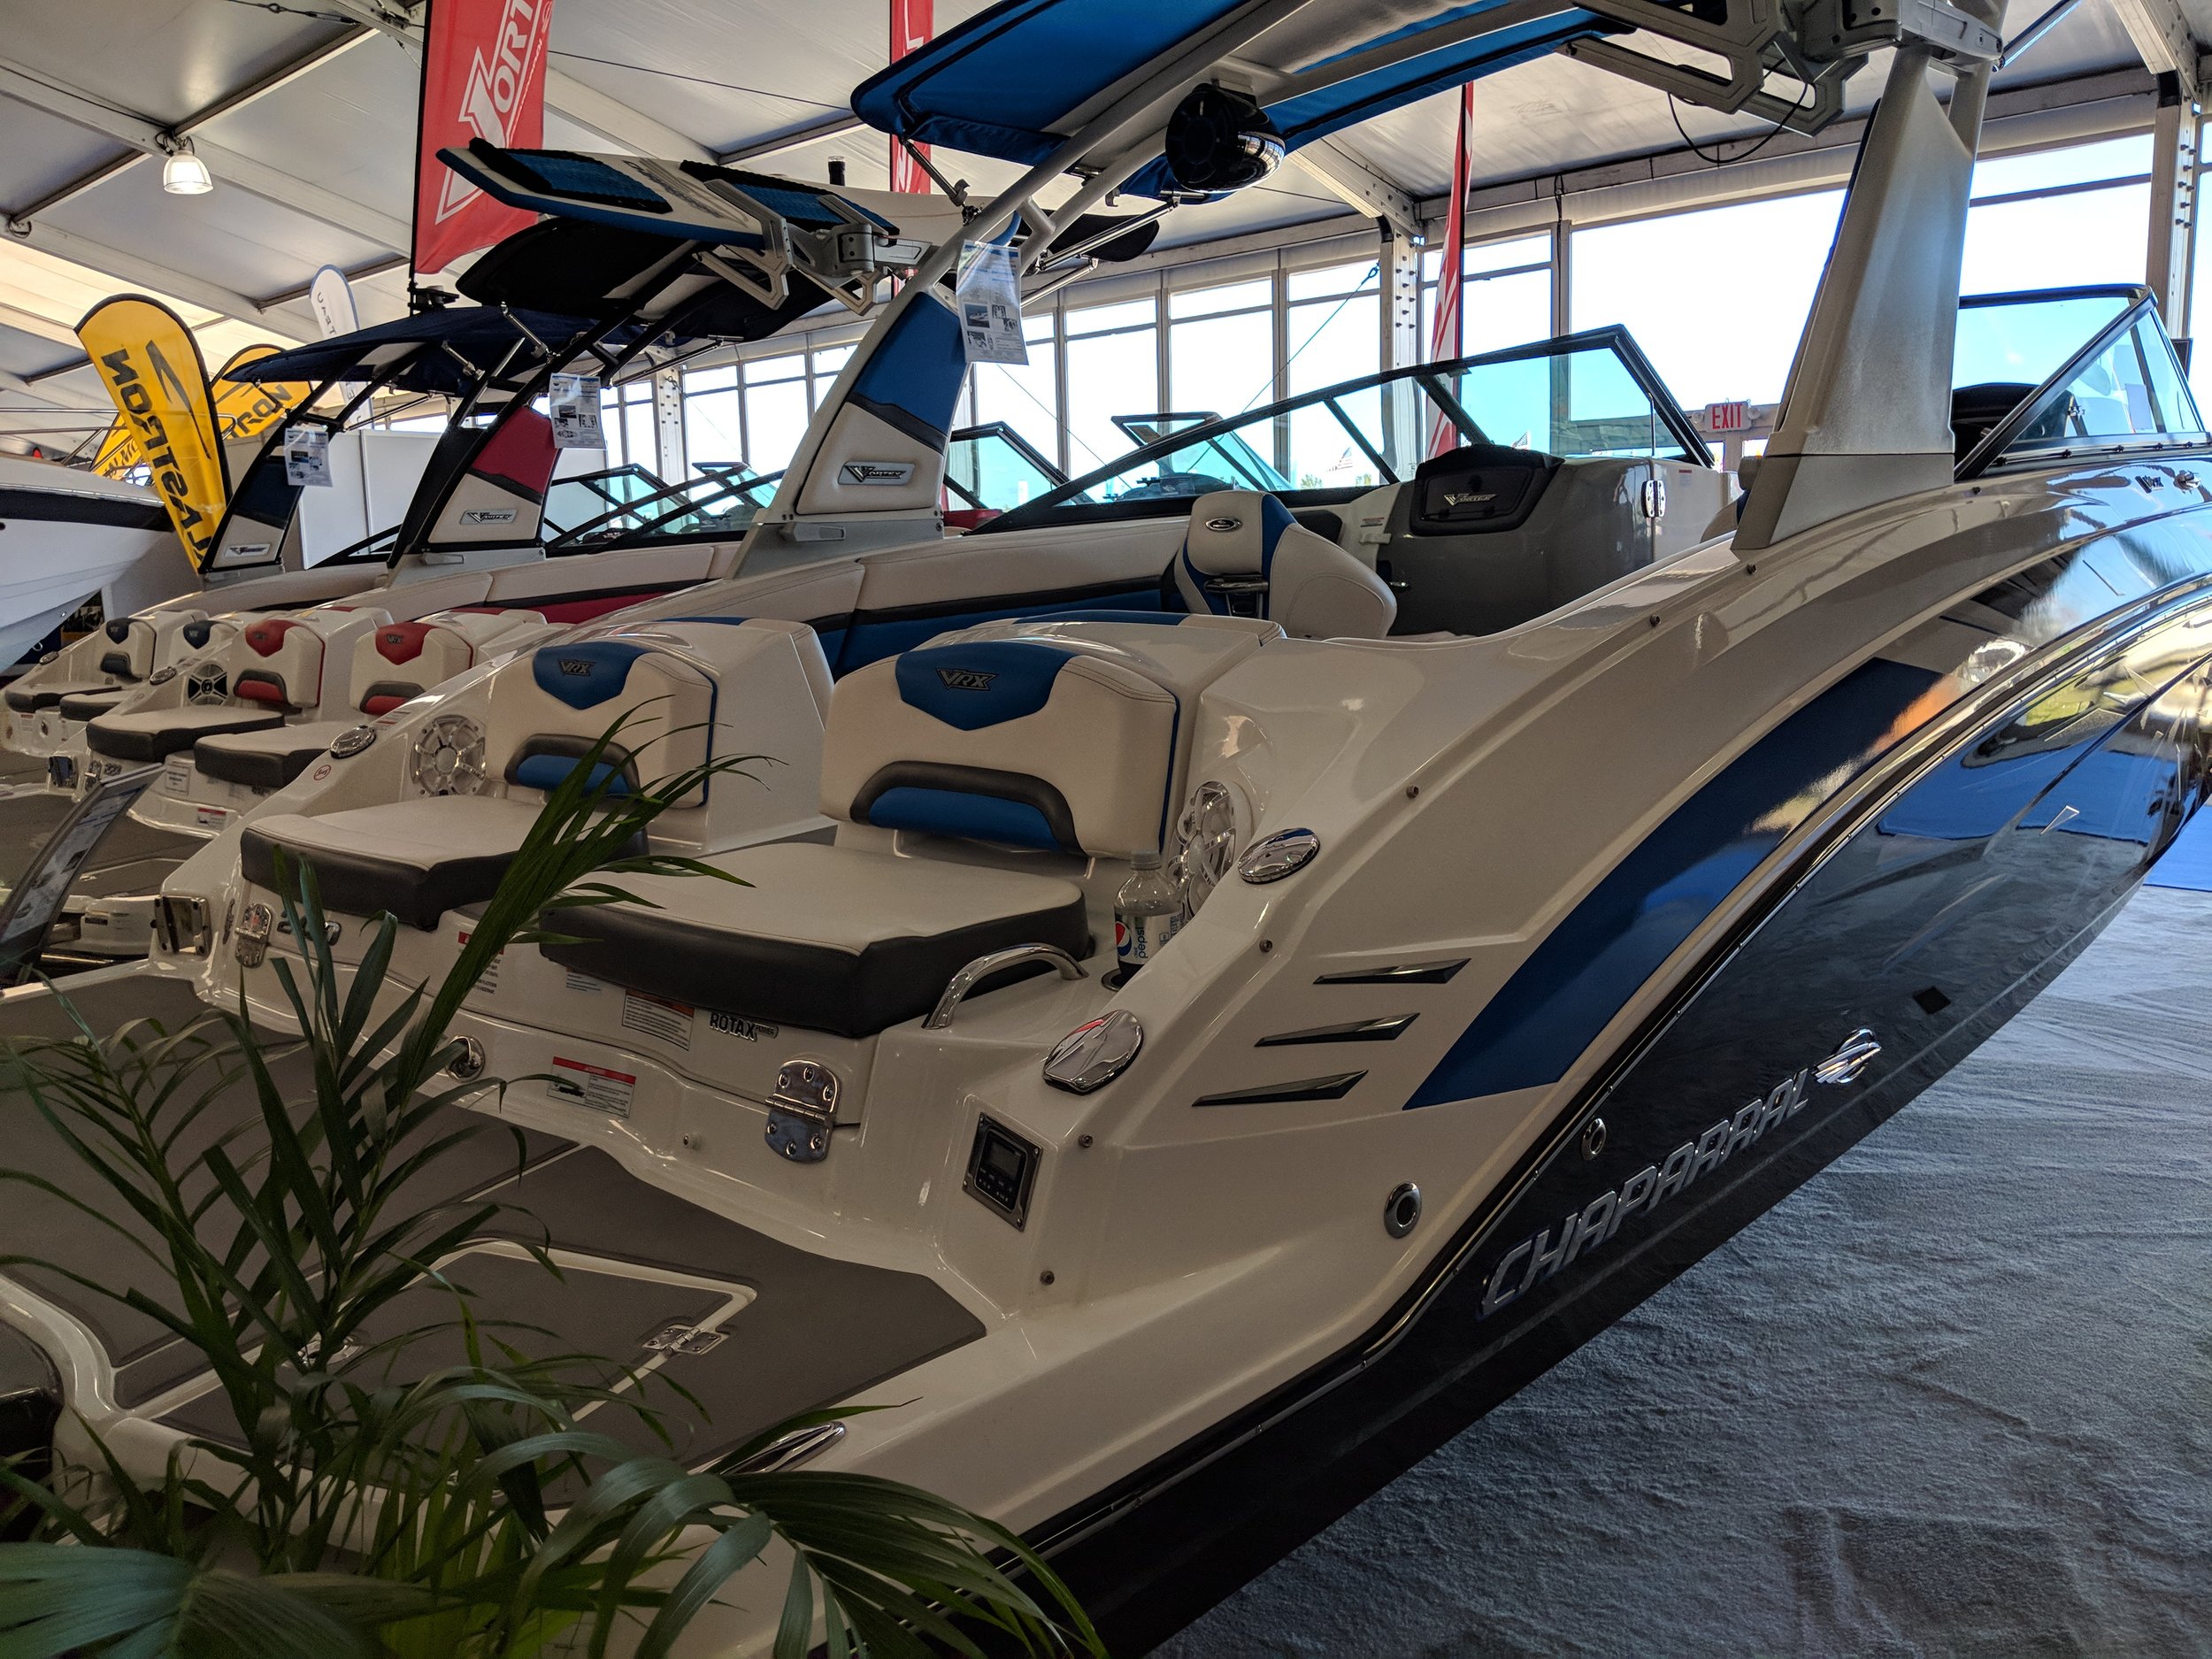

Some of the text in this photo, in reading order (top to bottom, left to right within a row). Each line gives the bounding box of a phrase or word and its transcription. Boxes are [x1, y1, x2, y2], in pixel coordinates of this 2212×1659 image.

[1711, 403, 1742, 429] EXIT
[559, 660, 593, 675] VRX
[939, 669, 993, 689] VRX
[1138, 926, 1148, 959] pepsi
[709, 1011, 757, 1041] ROTAX
[1481, 1068, 1810, 1316] CHAPARRAL
